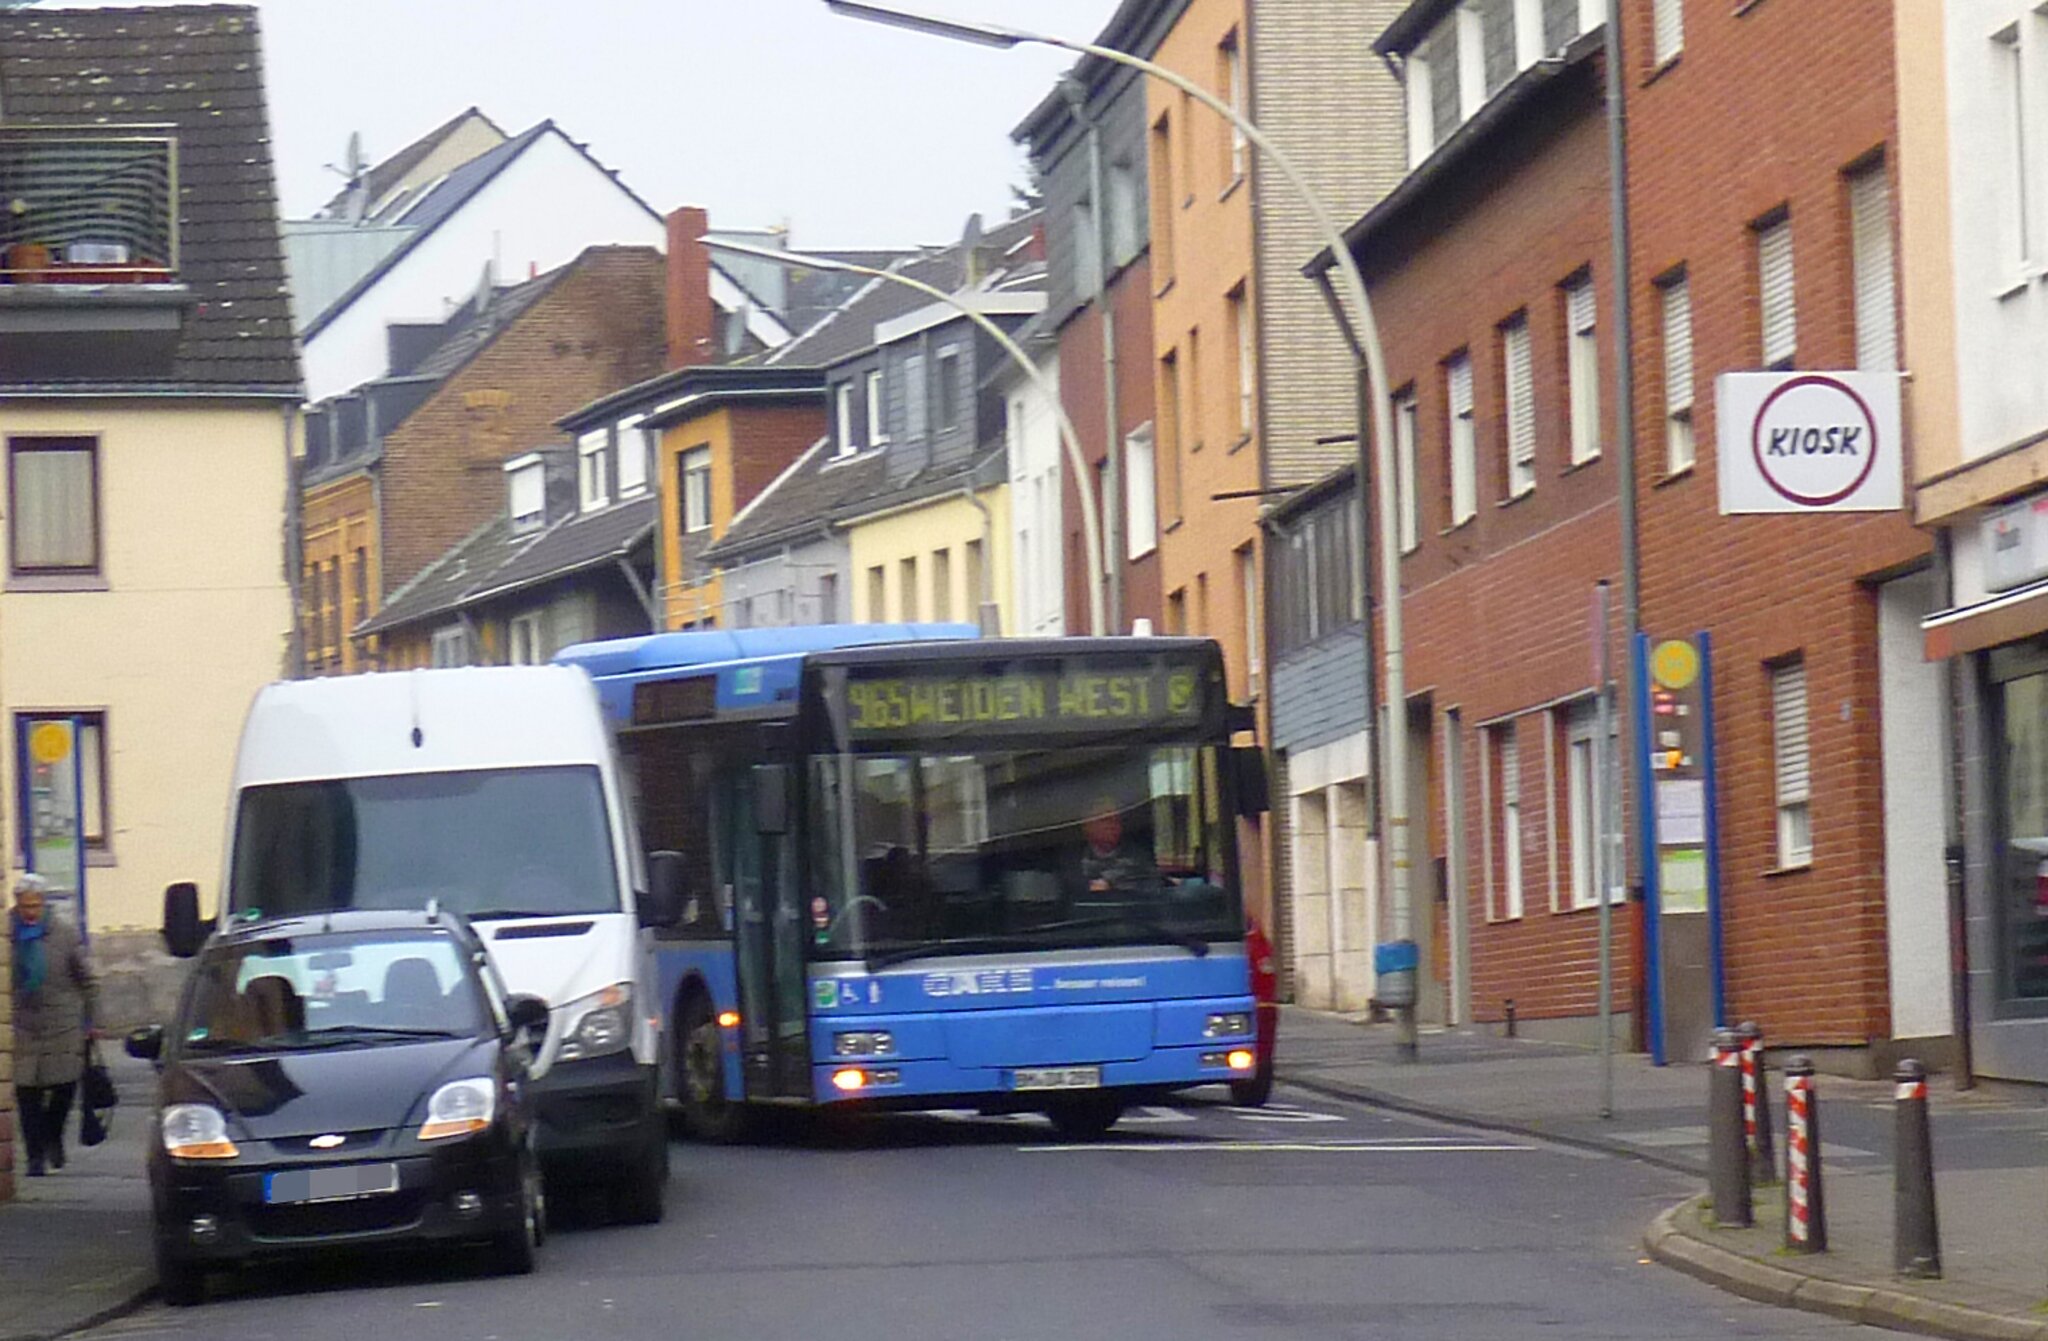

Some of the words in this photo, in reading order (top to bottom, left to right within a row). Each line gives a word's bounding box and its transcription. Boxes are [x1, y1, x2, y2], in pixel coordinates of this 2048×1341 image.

[1767, 427, 1861, 457] KIOSK
[909, 676, 1046, 724] WEIDEN
[1058, 675, 1149, 718] WEST
